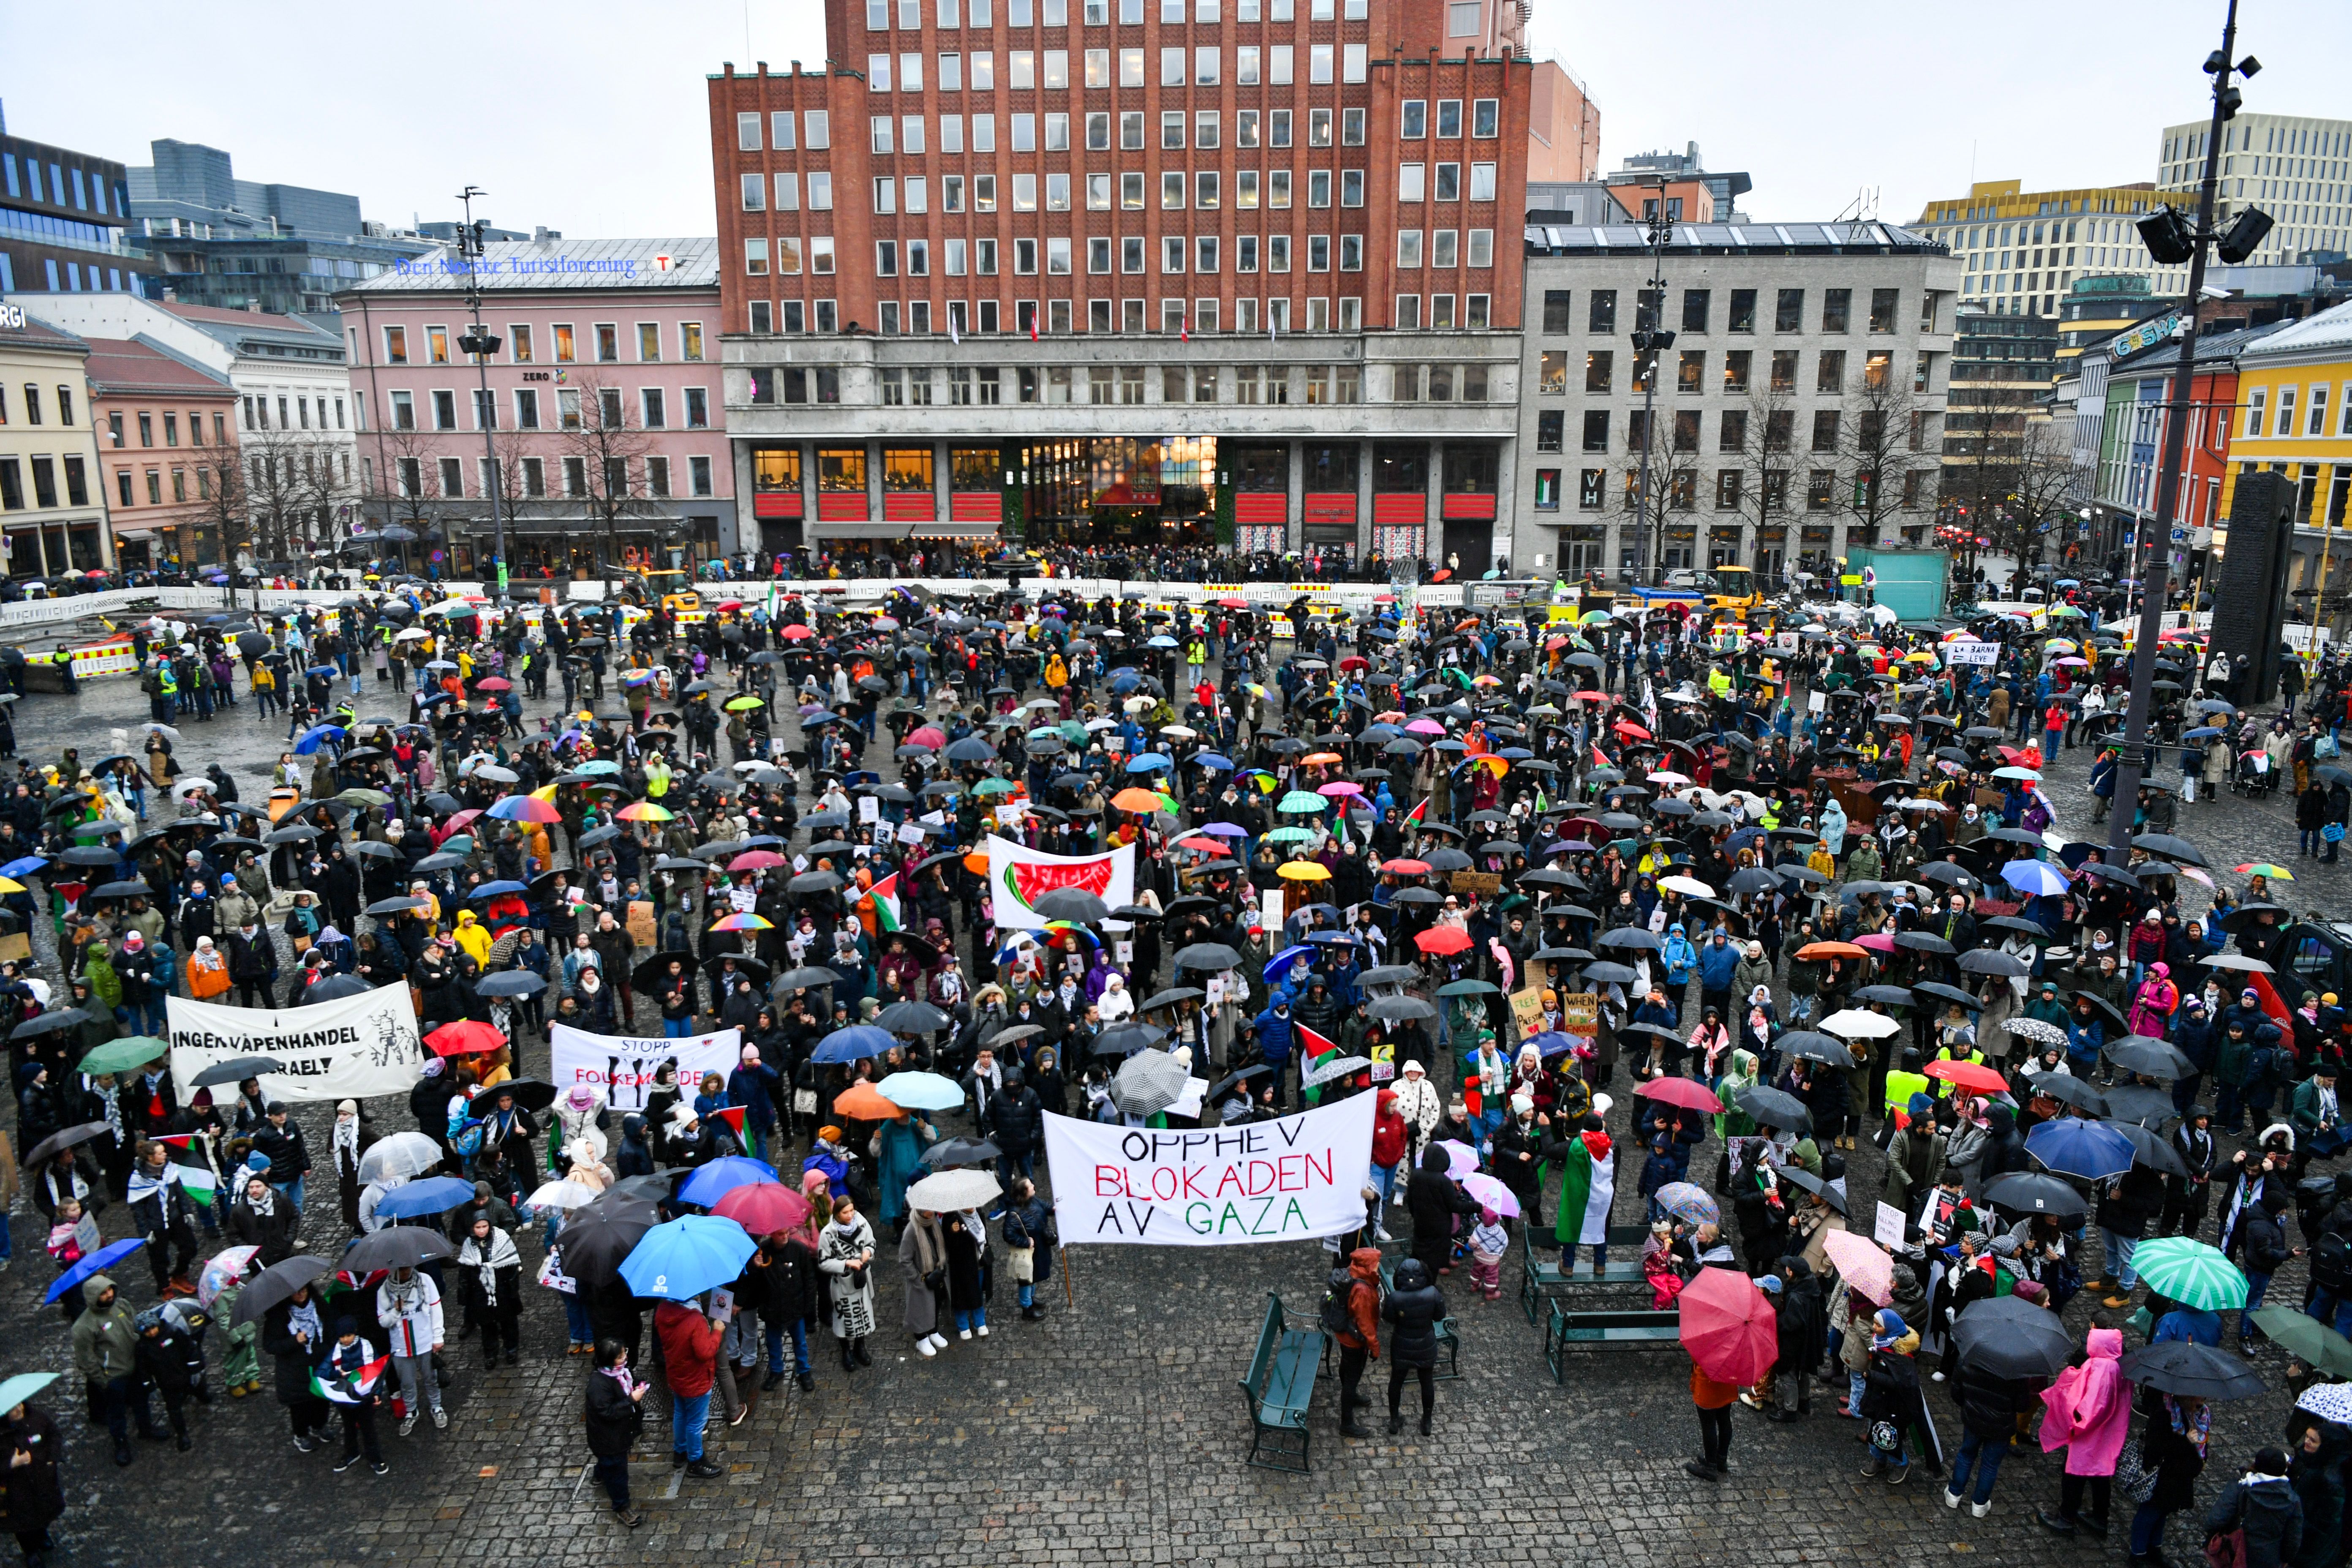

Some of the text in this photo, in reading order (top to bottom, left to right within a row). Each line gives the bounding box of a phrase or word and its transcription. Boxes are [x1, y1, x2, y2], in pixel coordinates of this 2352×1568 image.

[395, 255, 637, 279] Den Norske Turistforening
[657, 256, 669, 271] T
[0, 305, 26, 328] RGI
[523, 372, 549, 381] ZERO
[1456, 873, 1498, 884] SIONISME
[1452, 885, 1498, 895] FOLKEMORD
[1267, 896, 1278, 908] STOP
[632, 912, 649, 921] GAZA
[1263, 913, 1282, 925] GENOCIDE
[1514, 994, 1538, 1010] FREE
[1566, 995, 1595, 1006] WHEN
[1517, 1011, 1545, 1029] PALESTINE
[1566, 1024, 1597, 1034] ENOUGH
[172, 1026, 360, 1052] INGEN VÅPENHANDEL
[621, 1040, 671, 1053] STOPP
[270, 1057, 332, 1076] RAEL!
[575, 1068, 705, 1087] FOLKEMDE
[1122, 1116, 1305, 1162] OPPHEV
[1095, 1147, 1333, 1201] BLOKADEN
[1097, 1196, 1309, 1236] AV GAZA
[1881, 1205, 1899, 1219] STOP
[1878, 1215, 1897, 1228] KILLING
[1877, 1224, 1897, 1239] CHILDREN
[653, 1285, 668, 1293] BITS
[852, 1298, 865, 1337] TOFFEE
